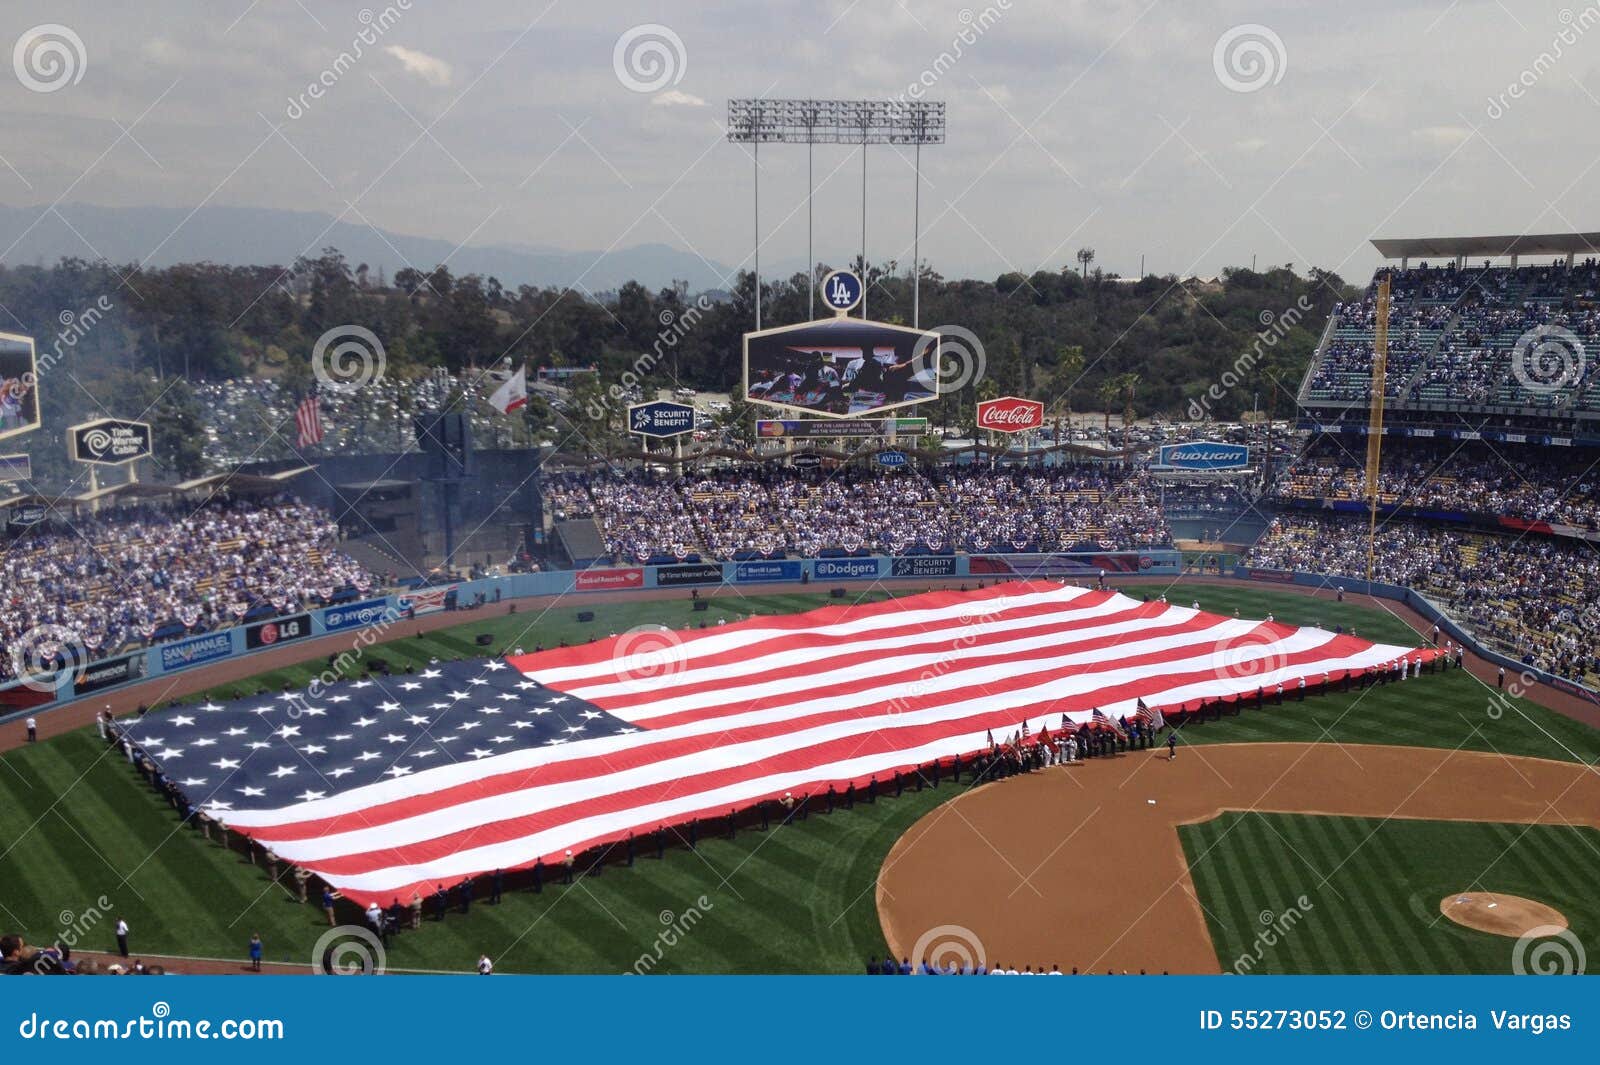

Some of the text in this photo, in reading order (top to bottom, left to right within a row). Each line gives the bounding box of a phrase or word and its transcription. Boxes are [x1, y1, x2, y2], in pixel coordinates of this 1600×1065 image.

[832, 276, 851, 304] LA
[654, 410, 691, 418] SECURITY
[112, 446, 139, 455] Cable
[881, 454, 905, 463] AVITA
[913, 559, 951, 567] SECURITY
[817, 562, 876, 576] @Dodgers
[280, 621, 299, 638] LG
[163, 647, 185, 661] SAN
[190, 636, 230, 653] MANUEL
